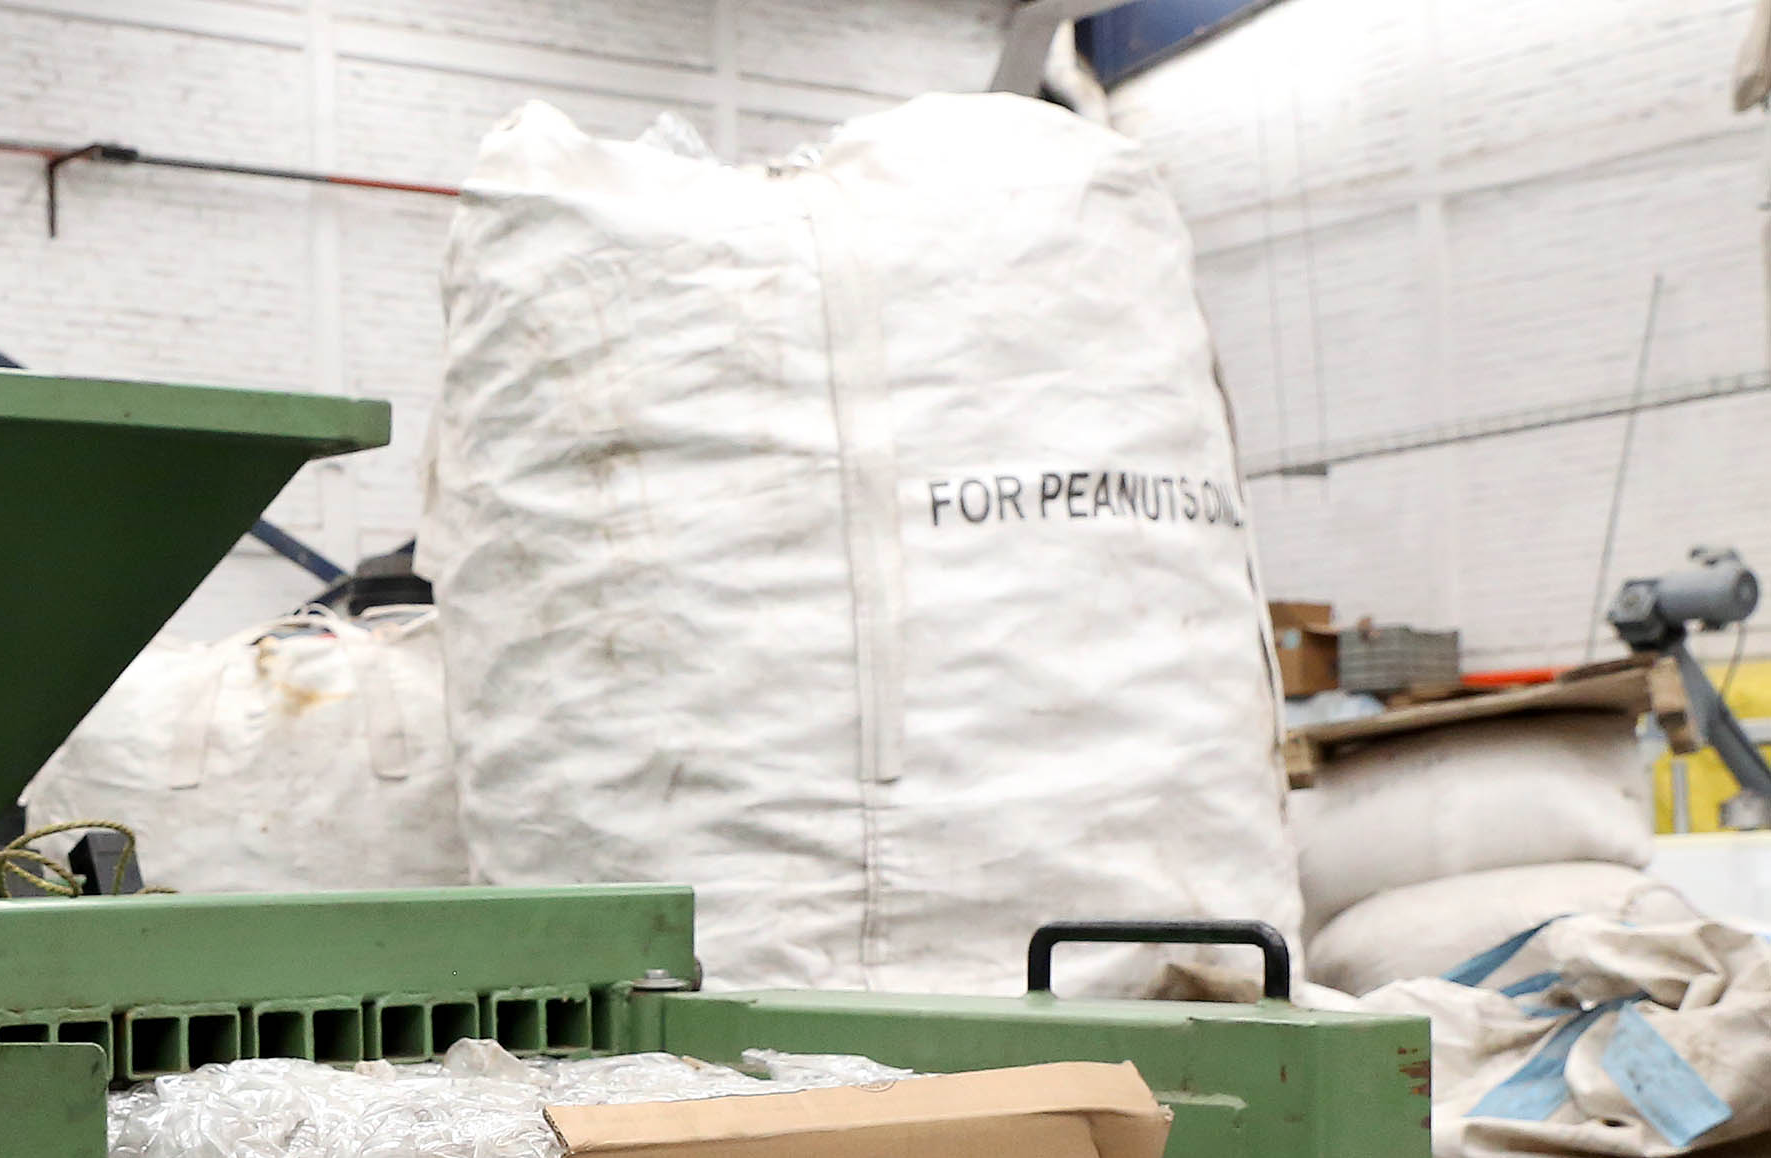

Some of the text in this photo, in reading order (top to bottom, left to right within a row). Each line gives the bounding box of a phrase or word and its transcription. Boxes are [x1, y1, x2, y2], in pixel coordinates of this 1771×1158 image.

[929, 472, 1244, 527] FOR PEANUTS ONL
